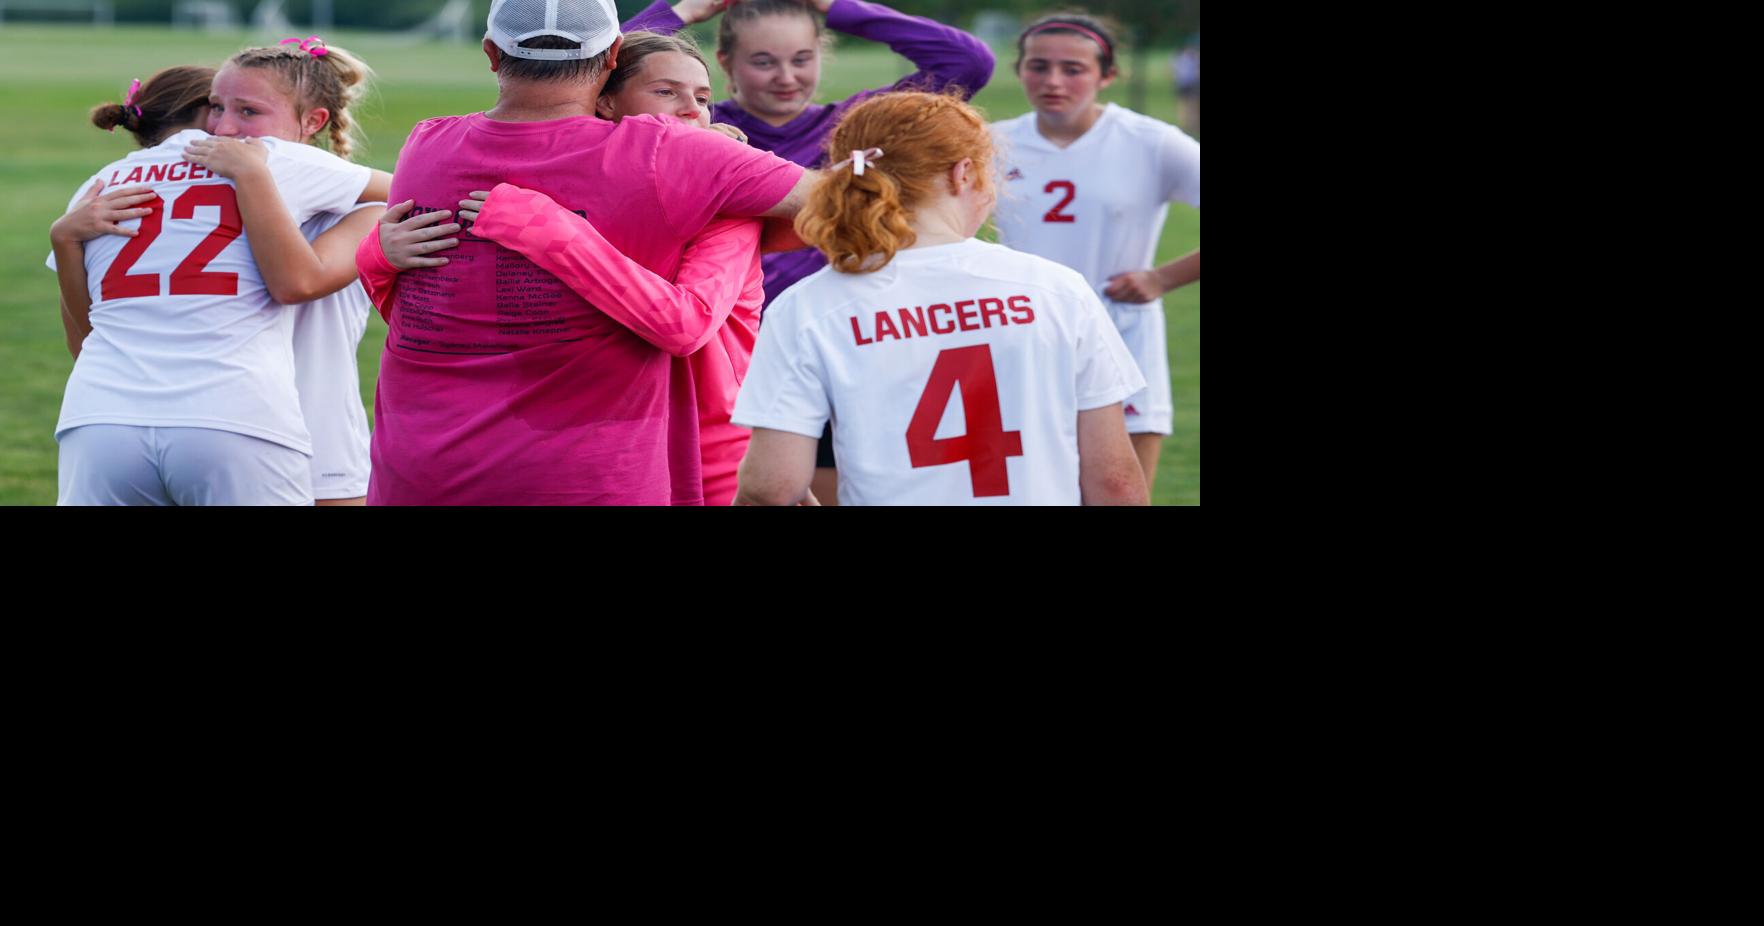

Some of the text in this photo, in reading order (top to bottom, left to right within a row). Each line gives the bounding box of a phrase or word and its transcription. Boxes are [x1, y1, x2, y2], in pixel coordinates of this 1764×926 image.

[108, 161, 224, 187] LANCE
[1043, 180, 1077, 222] 2
[101, 184, 243, 301] 22
[850, 295, 1035, 346] LANCERS
[905, 343, 1023, 498] 4
